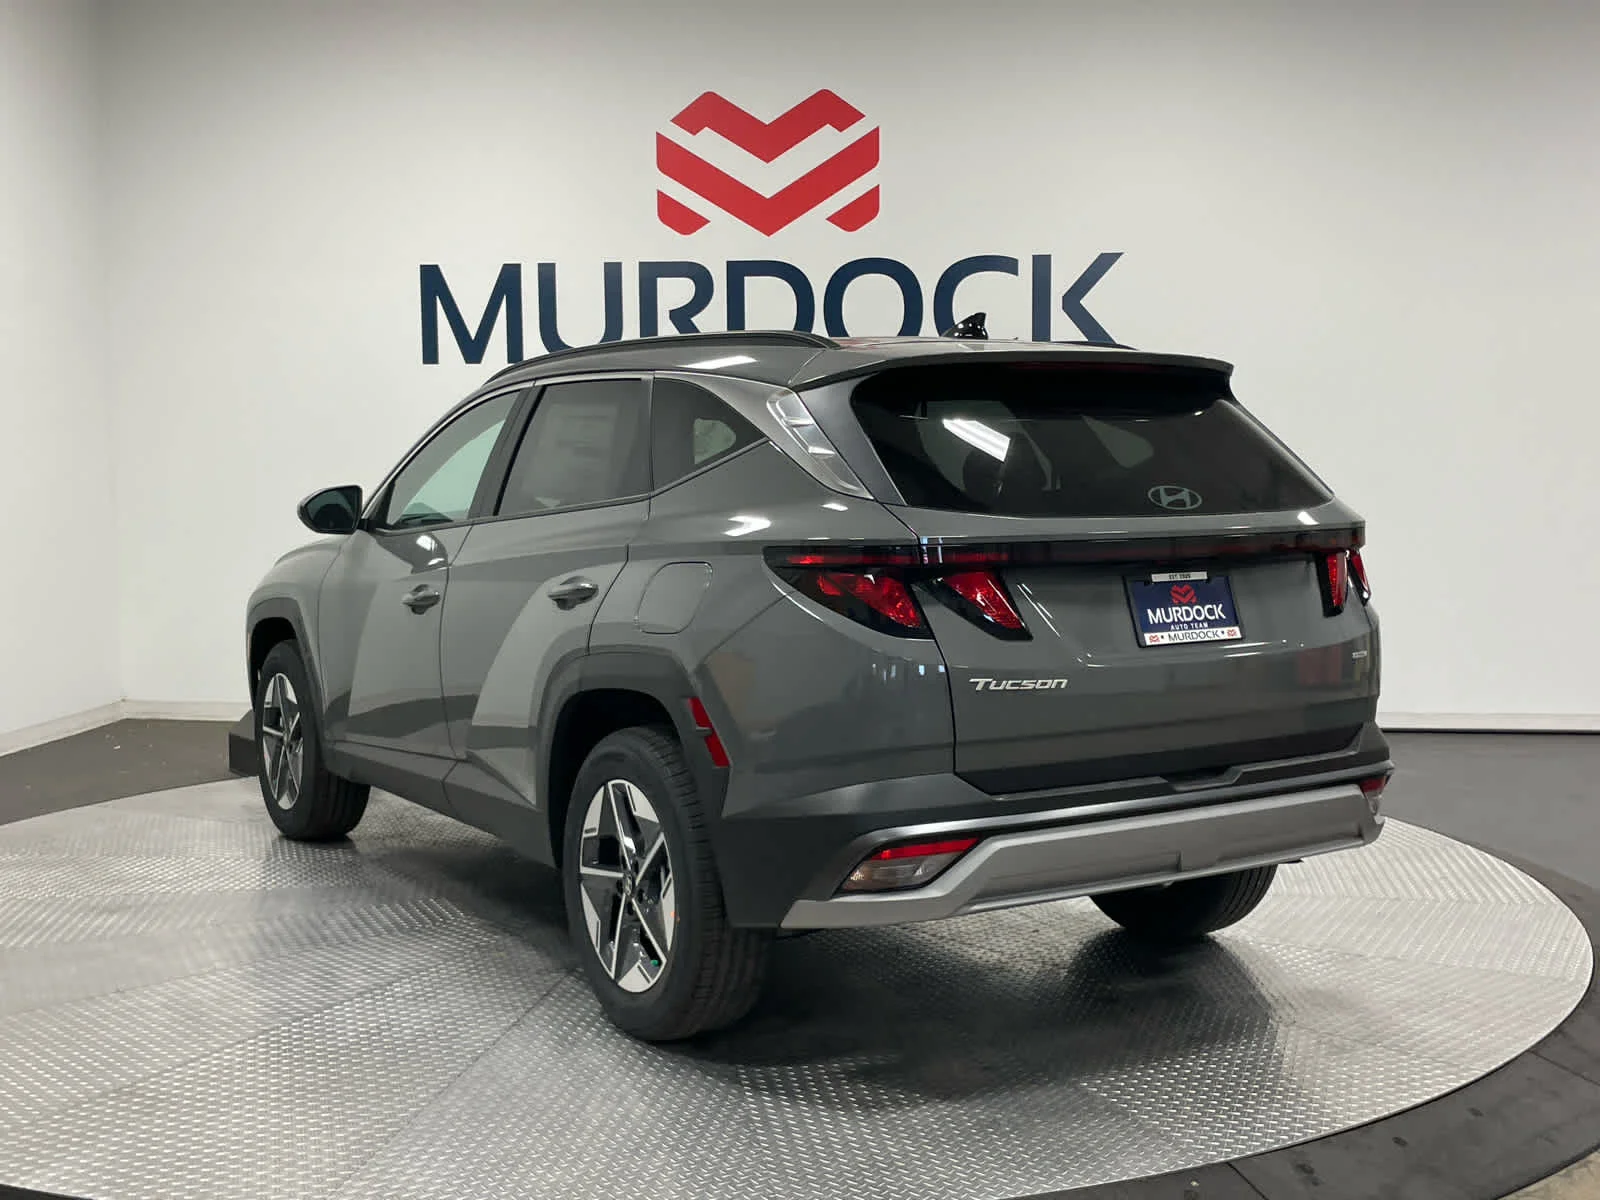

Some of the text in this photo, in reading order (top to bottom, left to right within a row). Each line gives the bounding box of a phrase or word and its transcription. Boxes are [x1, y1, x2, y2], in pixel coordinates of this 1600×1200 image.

[419, 252, 1125, 365] MURDOCK
[1146, 603, 1226, 625] MURDOCK
[1170, 621, 1209, 631] AUTO TEAM
[1168, 629, 1220, 641] MURDOCK
